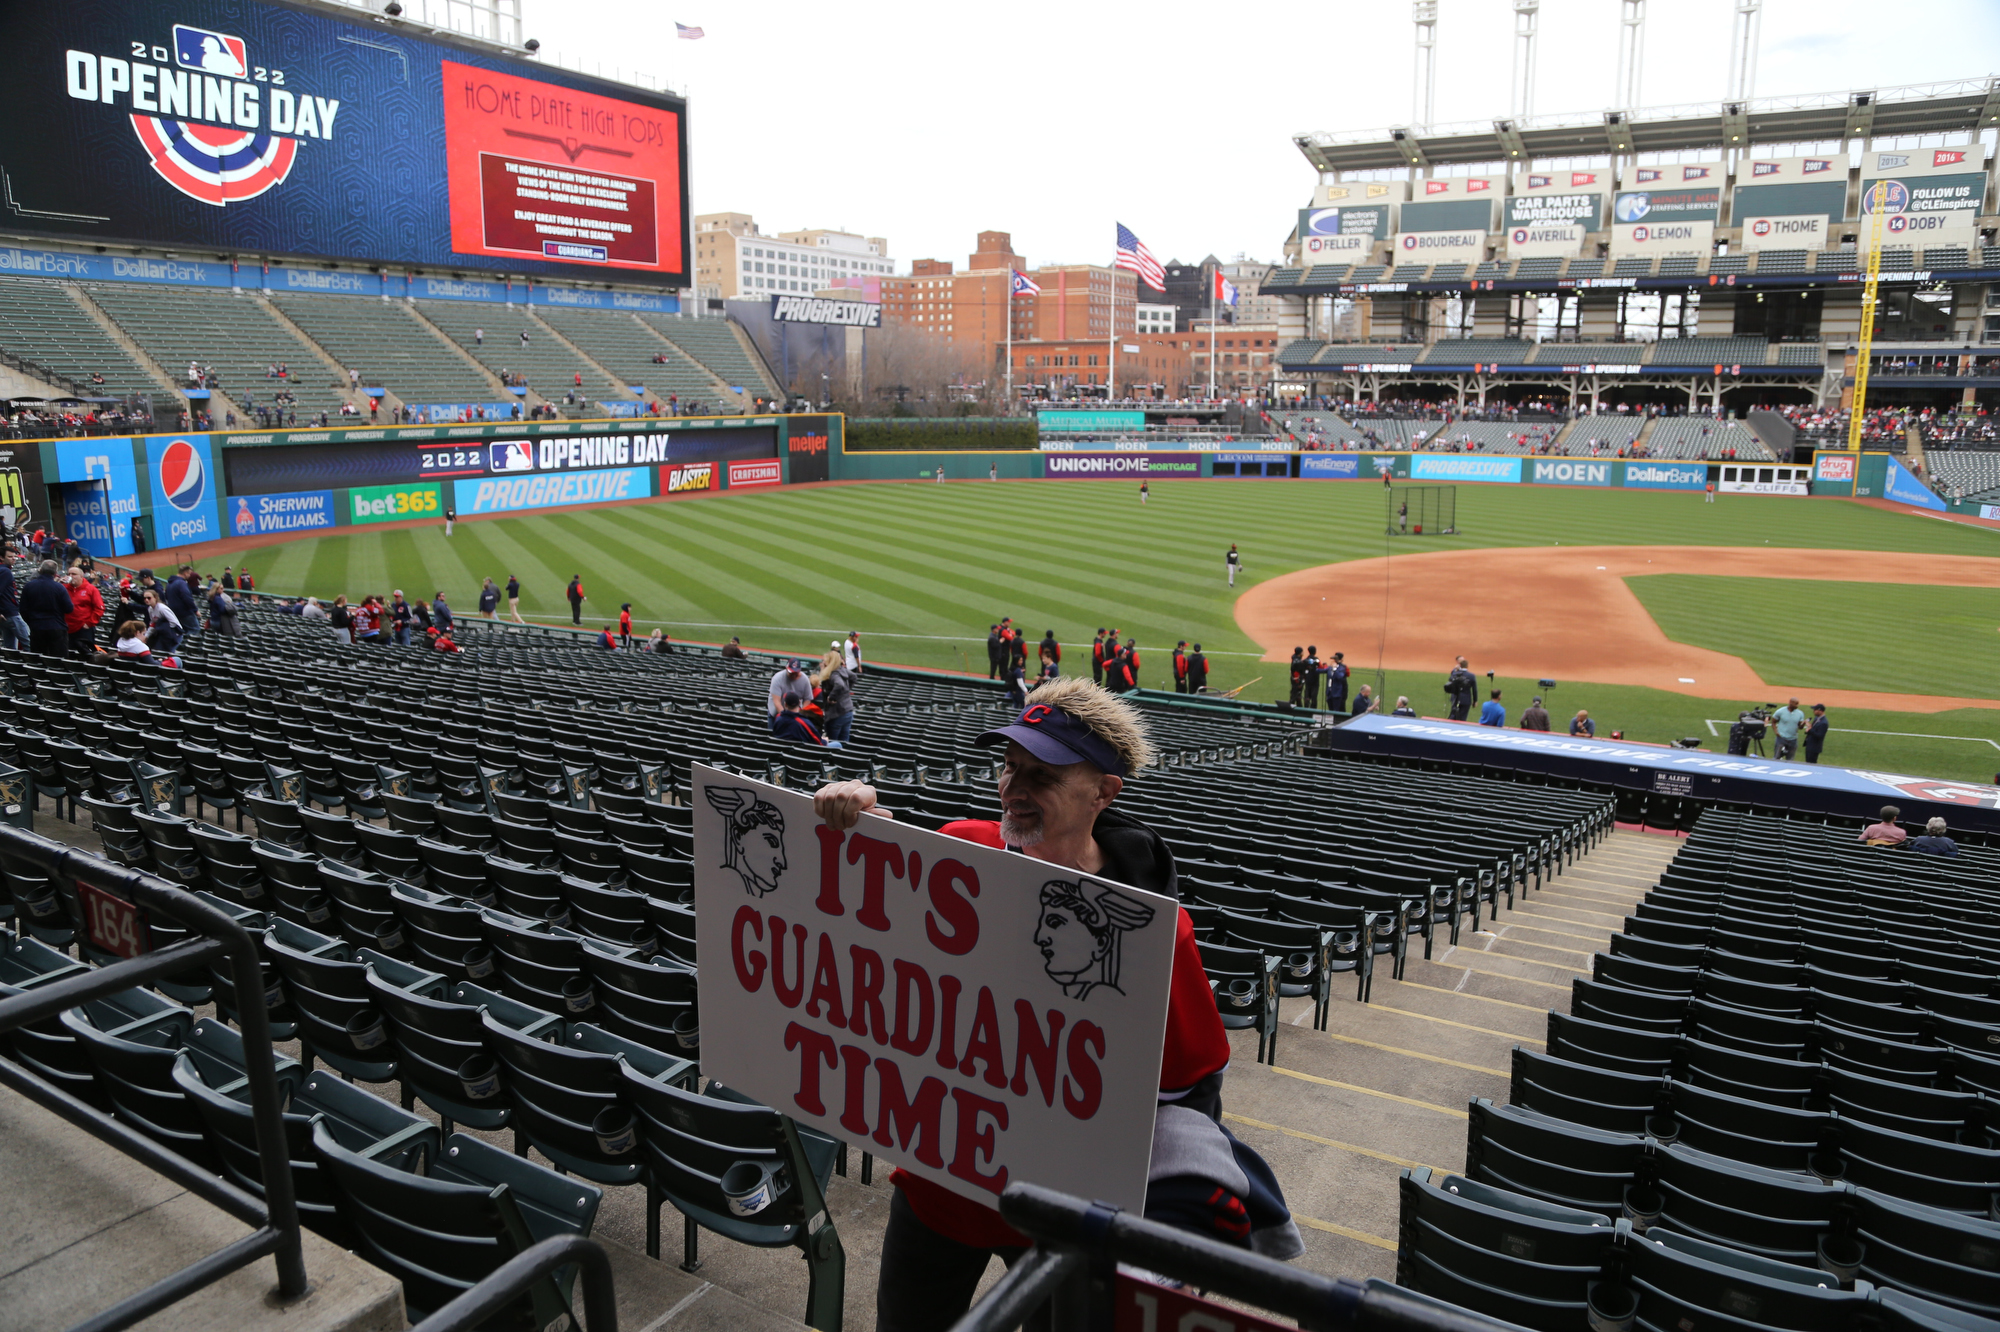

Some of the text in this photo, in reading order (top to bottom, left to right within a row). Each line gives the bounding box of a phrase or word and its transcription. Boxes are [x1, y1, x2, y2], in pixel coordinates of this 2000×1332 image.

[131, 41, 285, 85] 20 22
[66, 49, 340, 140] OPENING DAY
[465, 81, 663, 147] HOME PLATE HIGH TOPS
[1881, 157, 1898, 167] 2013
[1936, 152, 1955, 163] 2016
[1755, 164, 1771, 174] 2001
[1805, 161, 1822, 171] 2007
[505, 162, 519, 173] THE
[539, 167, 558, 179] PLATE
[575, 173, 591, 184] TOPS
[1573, 174, 1588, 184] 1997
[517, 176, 539, 188] VIEWS
[539, 178, 548, 188] OF
[548, 181, 561, 191] THE
[561, 183, 578, 194] FIELD
[578, 185, 586, 194] IN
[586, 186, 596, 196] AN
[1652, 193, 1719, 204] MINUTE MEN
[1913, 187, 1970, 199] FOLLOW US
[1515, 195, 1590, 209] CAR PARTS
[1652, 201, 1718, 212] STAFFING SERVICES
[1911, 197, 1980, 212] @CLEinspires
[1342, 210, 1379, 219] electronic
[1511, 206, 1593, 220] WAREHOUSE
[514, 209, 536, 221] ENJOY
[536, 212, 556, 224] GREAT
[557, 215, 574, 226] FOOD
[574, 217, 580, 227] &
[610, 222, 632, 233] OFFERS
[1342, 217, 1378, 227] merchant
[1774, 220, 1818, 234] THOME
[1891, 216, 1946, 230] 14 DOBY
[577, 228, 589, 239] THE
[1342, 226, 1374, 234] systems
[1530, 229, 1576, 242] AVERILL
[1650, 227, 1692, 239] LEMON
[1324, 238, 1361, 250] FELLER
[1419, 235, 1476, 248] BOUDREAU
[0, 249, 88, 275] ollarBank
[1877, 270, 1931, 281] OPENING DAY
[1396, 282, 1408, 292] DAY
[1622, 277, 1637, 287] DAY
[774, 296, 880, 327] PROGRESSIVE
[618, 422, 647, 430] PROGRESSIVE
[1050, 416, 1135, 425] MEDICAL MUTUAL
[397, 428, 436, 438] PROGRESSIVE
[448, 427, 484, 436] PROGRESSIVE
[494, 425, 529, 434] PROGRESSIVE
[538, 424, 571, 432] PROGRESSIVE
[580, 423, 610, 431] PROGRESSIVE
[226, 434, 275, 445] PROGRESSIVE
[287, 433, 331, 442] PROGRESSIVE
[344, 431, 386, 440] PROGRESSIVE
[789, 431, 828, 455] meijer
[1040, 442, 1073, 450] MOEN
[1115, 442, 1148, 450] MOEN
[1188, 442, 1220, 450] MOEN
[1260, 442, 1293, 450] MOEN
[421, 434, 667, 470] 2022 OPENING DAY
[1149, 463, 1197, 471] MORTGAGE
[1304, 457, 1357, 473] FirstEnergy
[1416, 460, 1514, 477] PROGRESSIVE
[1820, 459, 1848, 471] drug
[733, 467, 777, 481] CRAFTSMAN
[1535, 463, 1606, 482] MOEN
[1822, 469, 1852, 479] mart
[668, 467, 712, 492] BLASTER
[473, 470, 631, 511] PROGRESSIVE
[1754, 484, 1798, 494] CLIFFS
[1856, 487, 1870, 495] 325
[259, 496, 324, 514] SHERWIN
[354, 490, 437, 517] bet365
[260, 512, 326, 531] WILLIAMS
[70, 520, 125, 540] Clinic
[171, 515, 206, 541] pepsi
[1023, 704, 1052, 724] C
[1385, 723, 1813, 777] PROGRESSIVE FIELD
[1668, 774, 1691, 783] ALERT
[815, 823, 981, 956] IT'S
[89, 893, 138, 956] 164
[731, 904, 1106, 1120] GUARDIANS
[784, 1021, 1009, 1195] TIME
